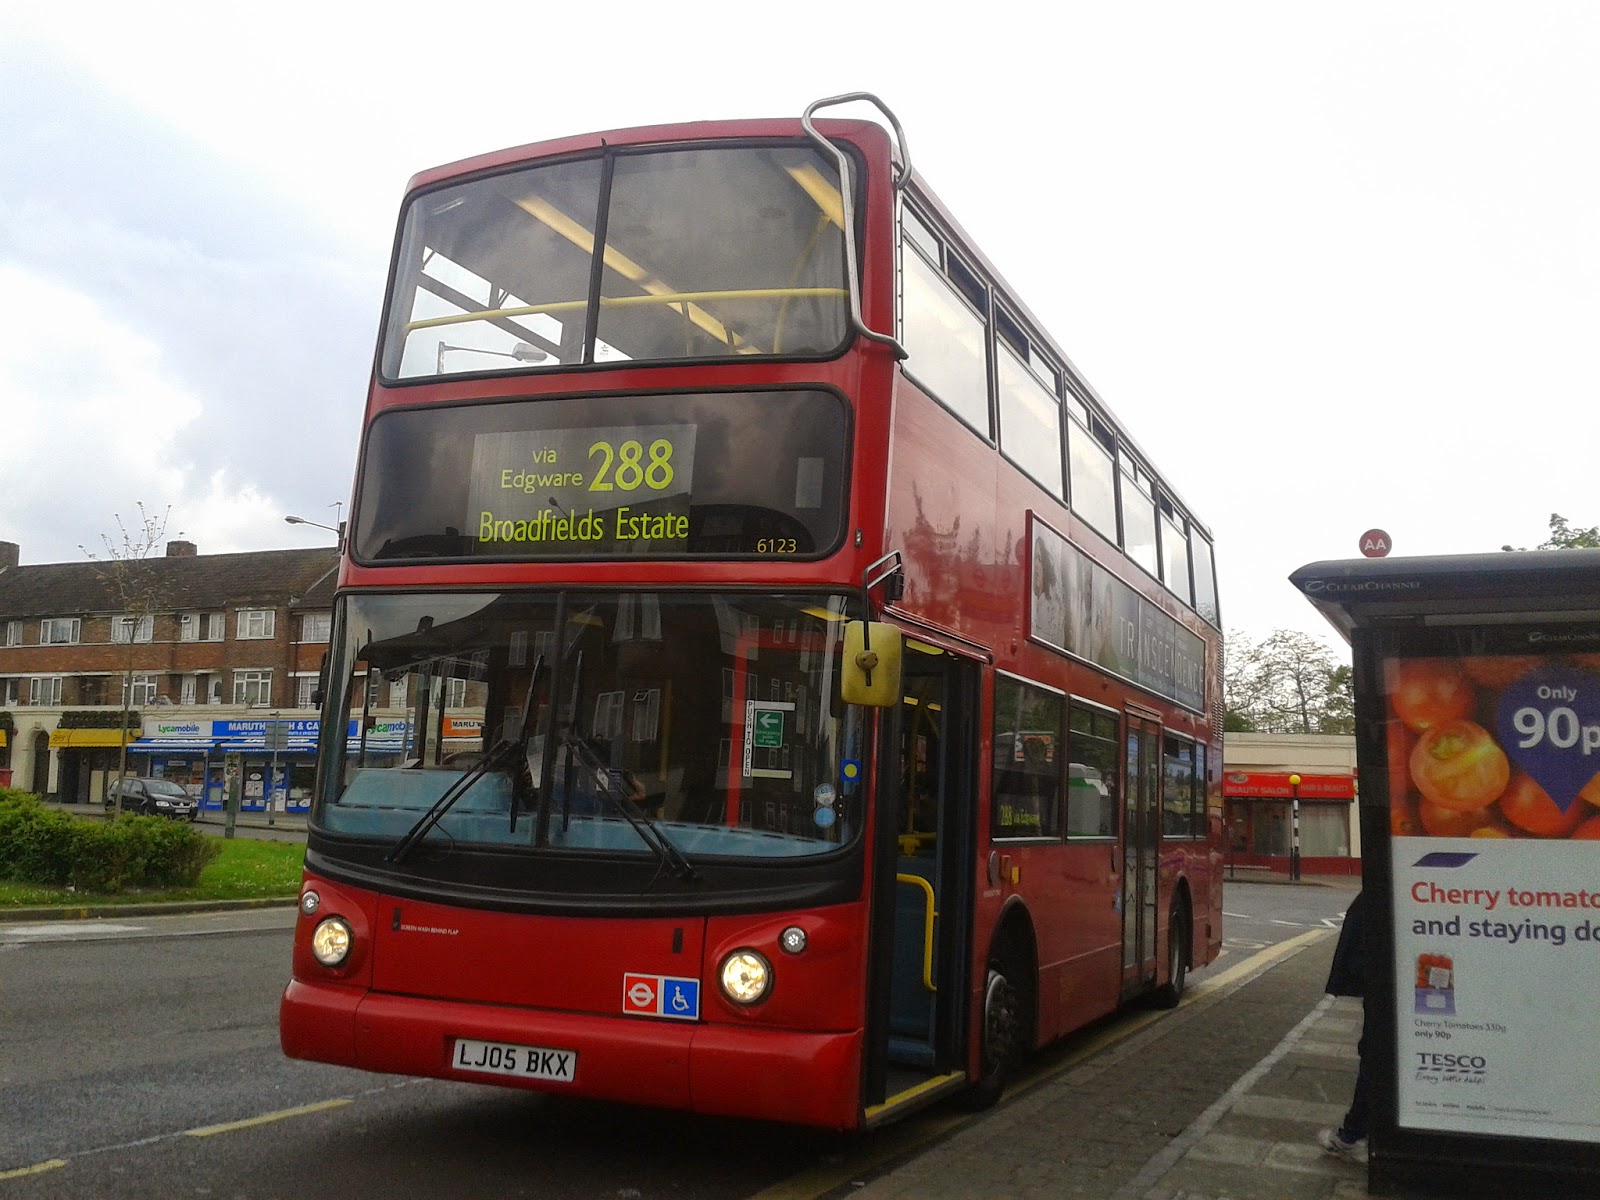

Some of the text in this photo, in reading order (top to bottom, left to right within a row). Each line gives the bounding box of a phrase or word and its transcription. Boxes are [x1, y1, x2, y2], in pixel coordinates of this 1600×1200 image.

[532, 447, 557, 463] via
[588, 439, 674, 492] 288
[501, 469, 583, 494] Edgware
[479, 507, 689, 542] Broadfields Estate
[757, 538, 797, 553] 6123
[1364, 538, 1387, 550] AA
[1537, 685, 1578, 702] Only
[158, 723, 200, 733] Lycamobile
[228, 722, 266, 731] MARUTH
[1513, 707, 1600, 756] 90p
[1411, 881, 1499, 910] Cherry
[1412, 915, 1461, 936] and
[1469, 919, 1566, 945] staying
[1414, 1030, 1452, 1040] only 90p
[460, 1044, 569, 1076] LJ05 BKX
[1416, 1052, 1486, 1068] TESCO
